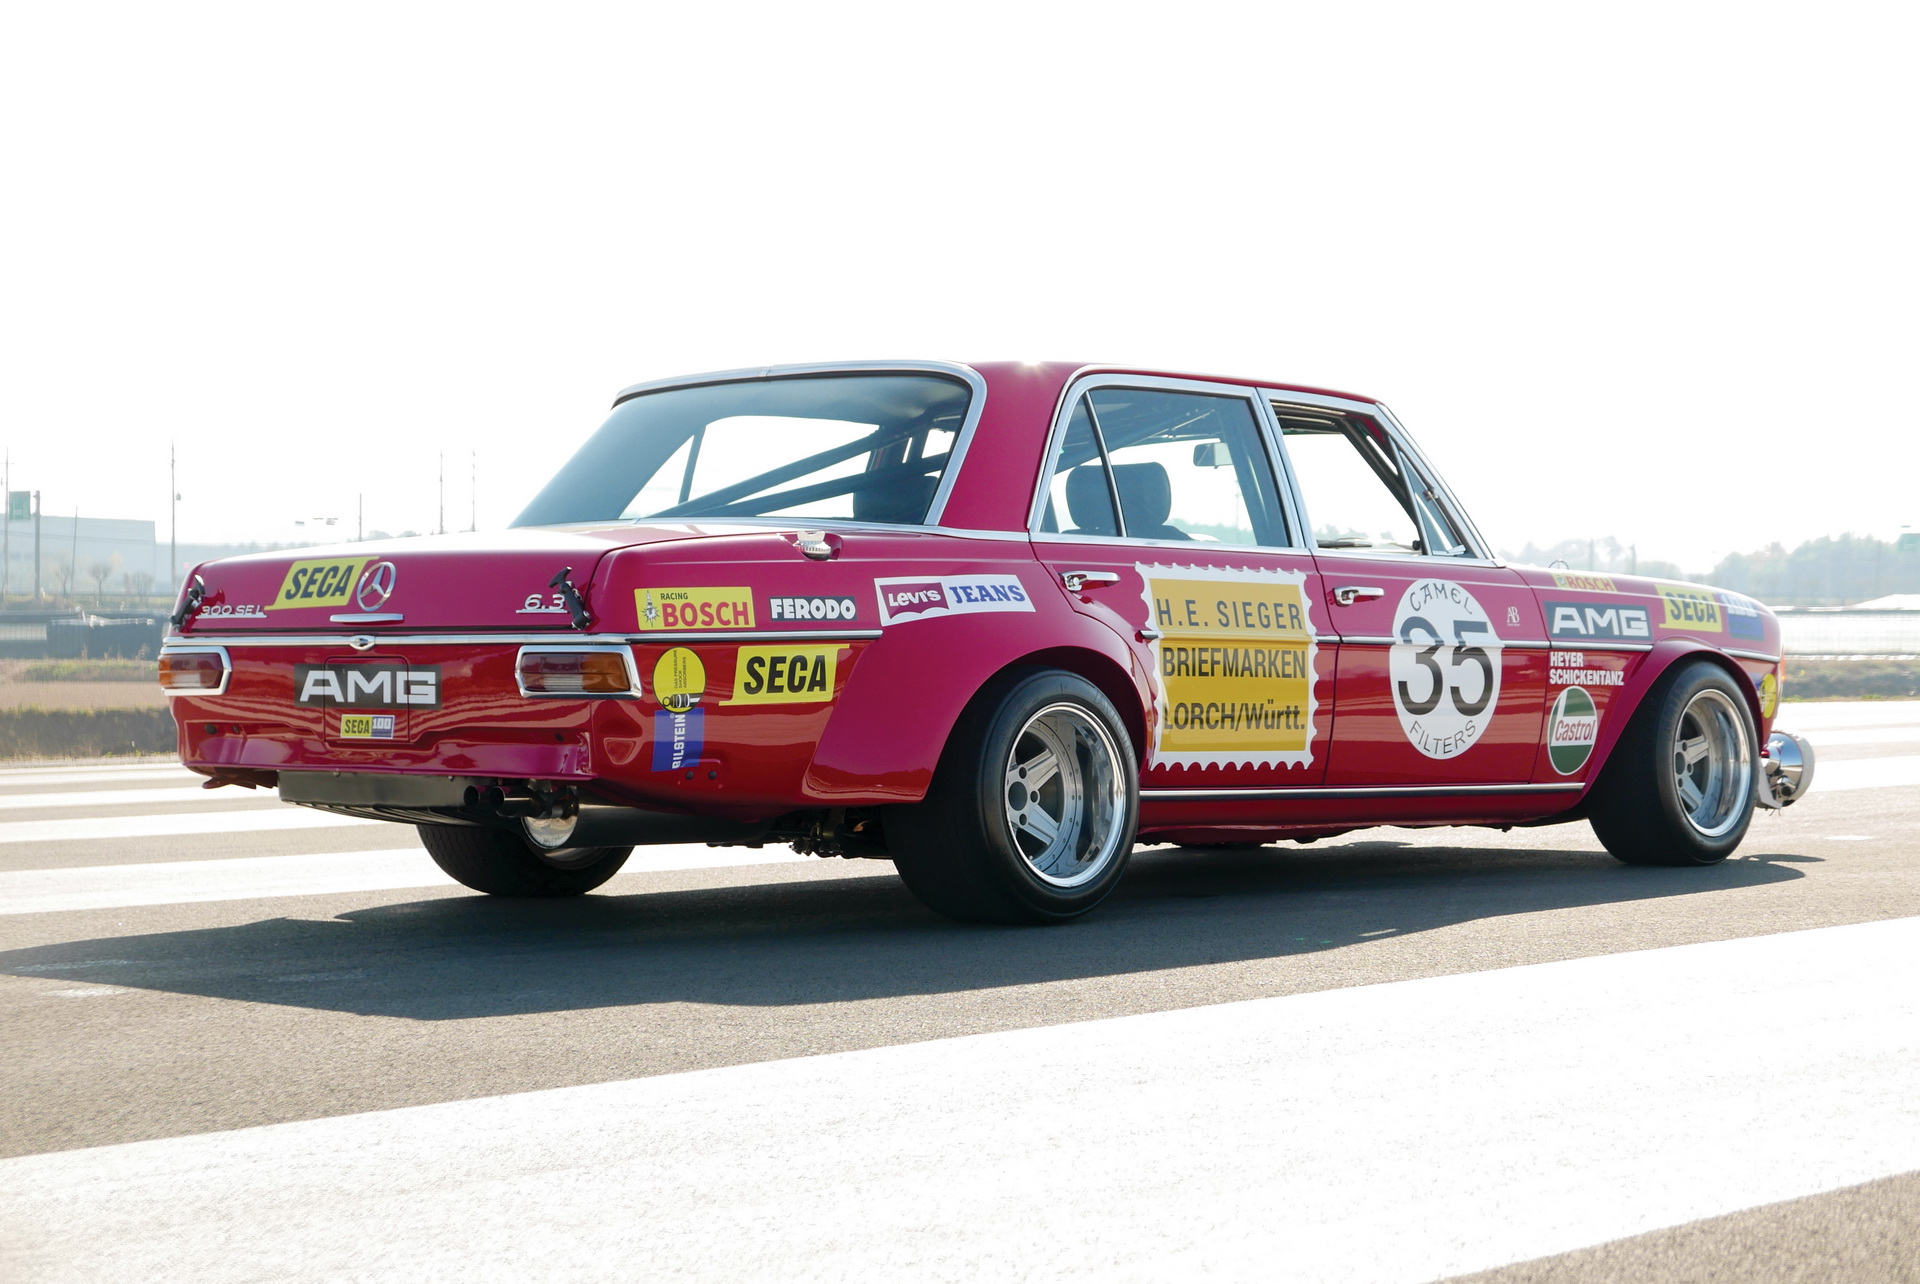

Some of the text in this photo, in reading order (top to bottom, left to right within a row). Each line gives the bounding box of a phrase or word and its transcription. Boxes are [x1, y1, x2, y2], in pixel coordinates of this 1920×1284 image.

[285, 565, 355, 600] SECA
[660, 592, 688, 601] RACING
[949, 585, 1026, 604] JEANS
[1565, 575, 1616, 591] BOSCH
[201, 604, 264, 615] 300 SEL
[524, 594, 565, 610] 6.3
[770, 598, 856, 620] FERODO
[1156, 598, 1303, 630] H.E. SIEGER
[1409, 582, 1473, 615] CAMEL
[1665, 592, 1718, 624] SECA
[662, 602, 750, 627] BOSCH
[1552, 606, 1649, 637] AMG
[1162, 647, 1306, 679] BRIEFMARKEN
[1398, 616, 1494, 717] 35
[1549, 651, 1583, 667] HEYER
[300, 670, 437, 705] AMG
[743, 655, 827, 695] SECA
[1549, 669, 1625, 686] SCHICKENTANZ
[344, 719, 370, 734] SECA
[1163, 698, 1306, 732] LORCH/Württ.
[1554, 719, 1596, 742] Castrol
[671, 714, 686, 769] BILSTEIN
[1409, 720, 1476, 755] FILTERS
